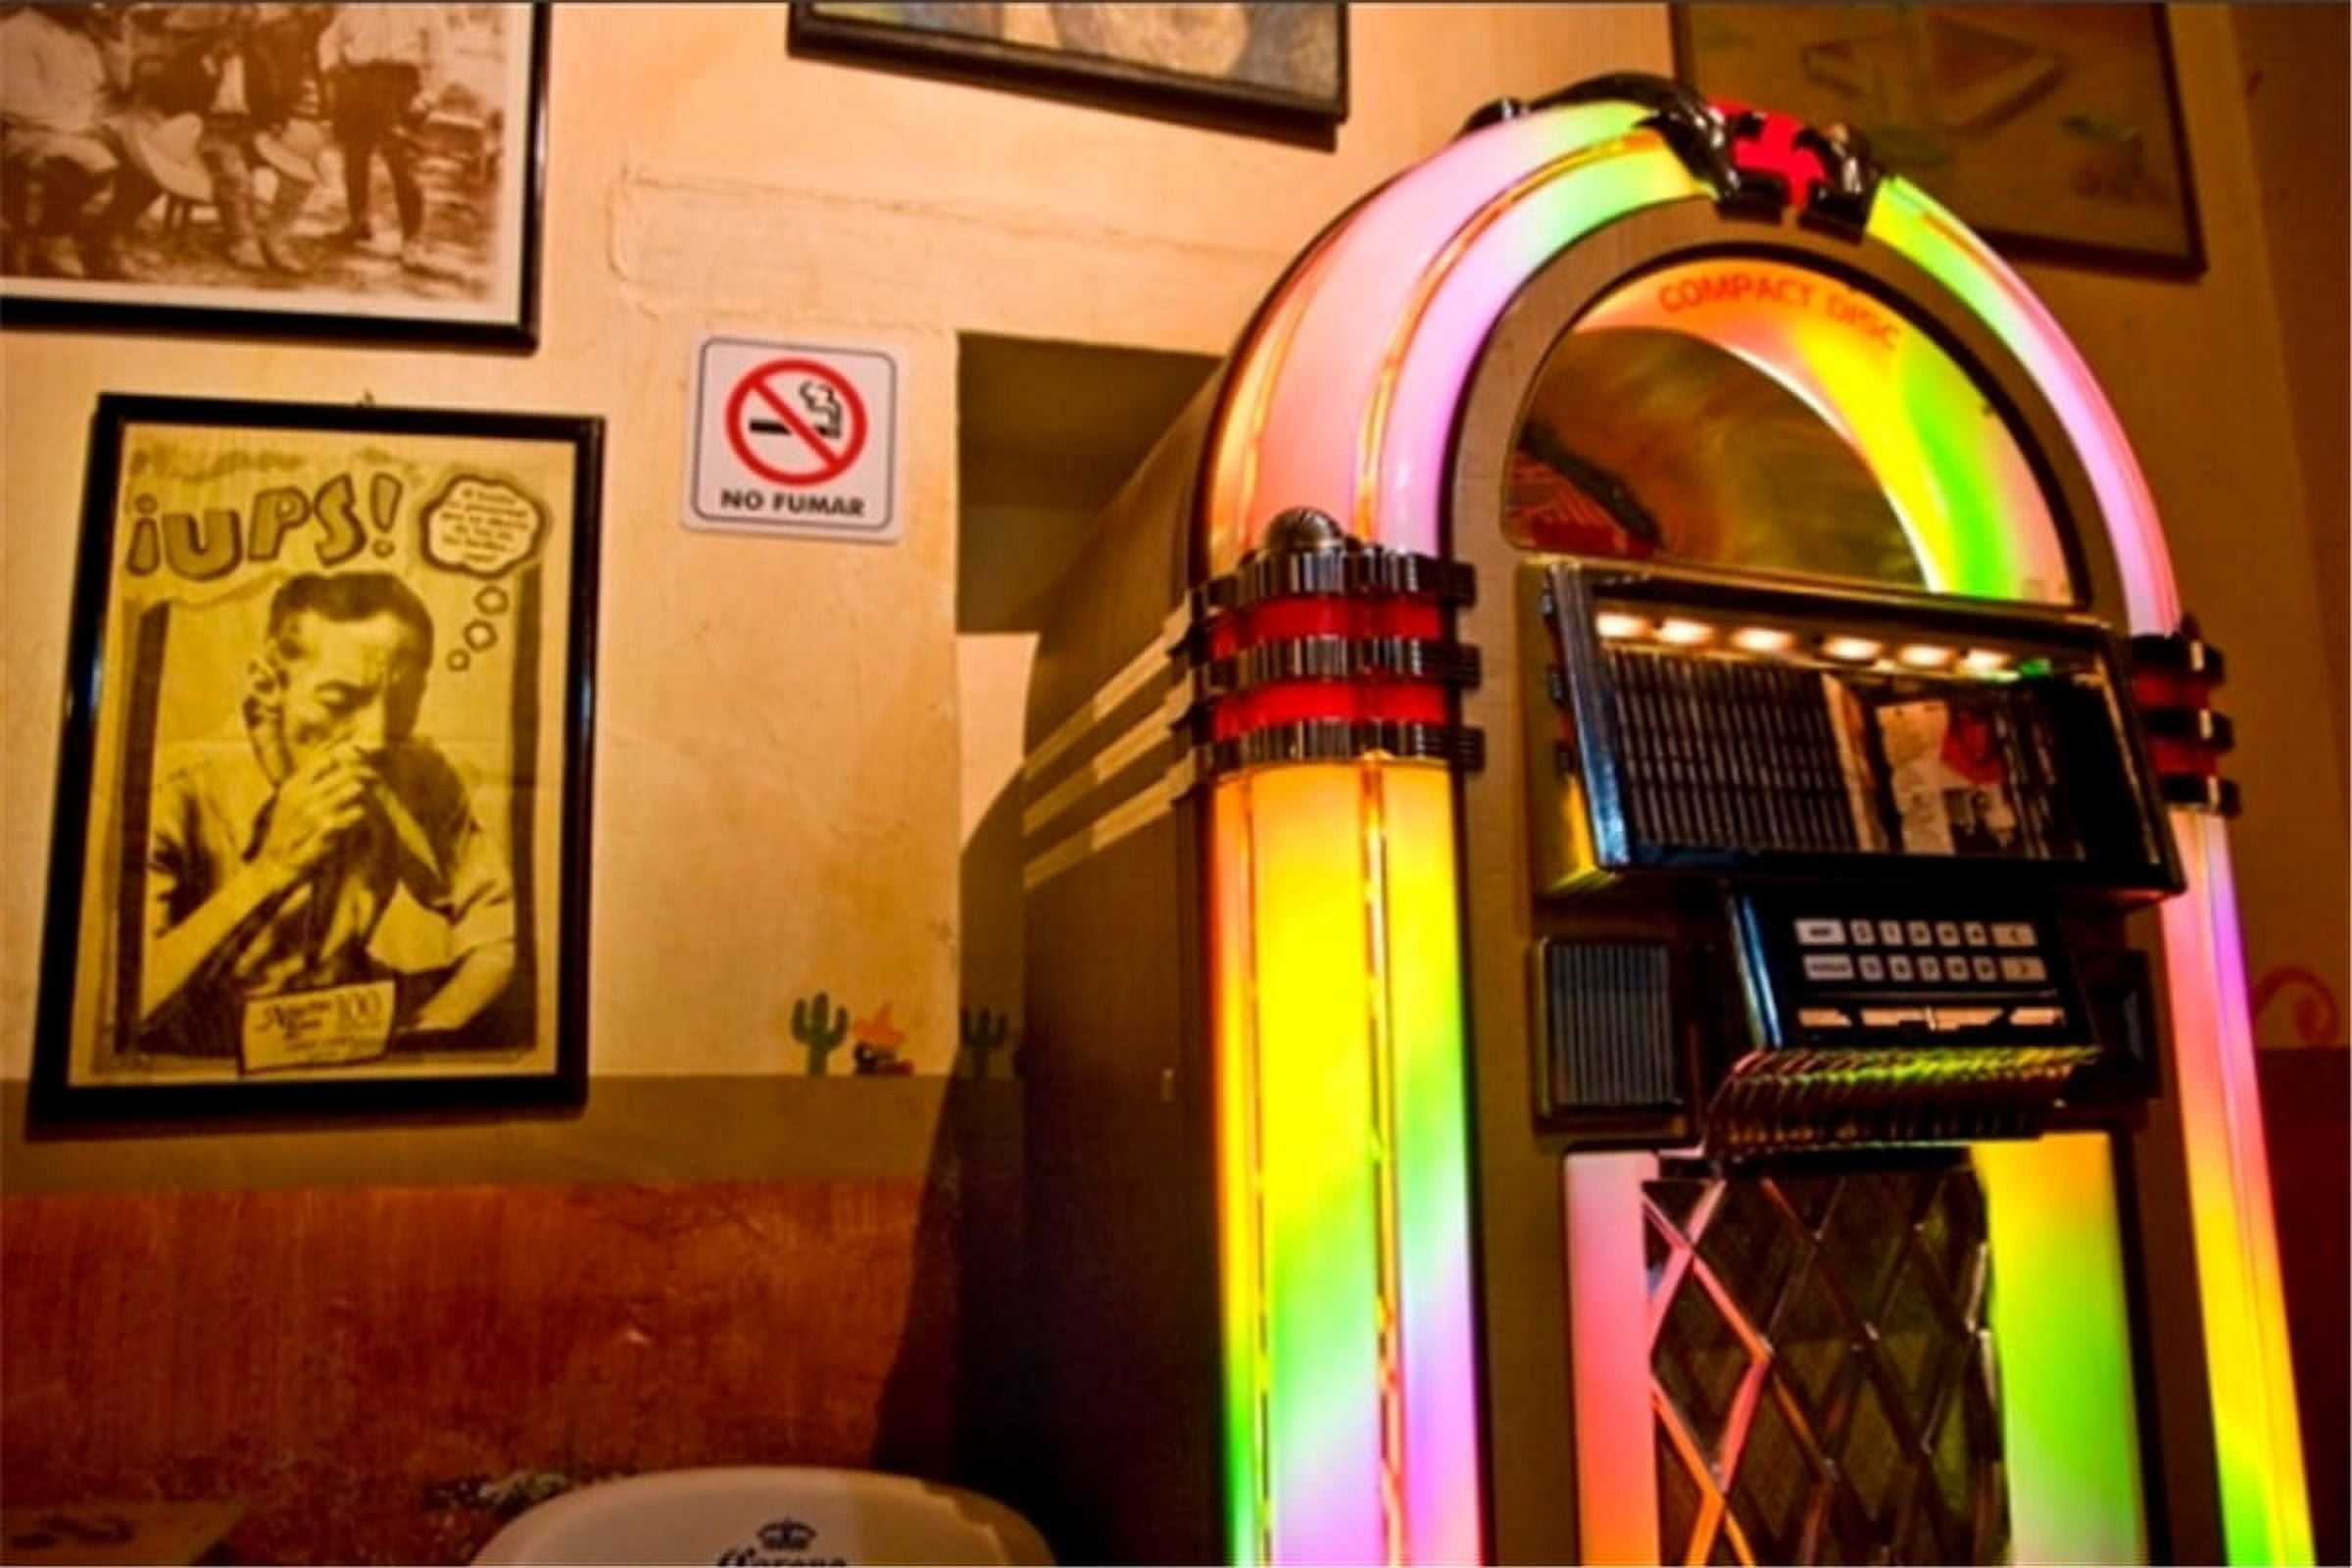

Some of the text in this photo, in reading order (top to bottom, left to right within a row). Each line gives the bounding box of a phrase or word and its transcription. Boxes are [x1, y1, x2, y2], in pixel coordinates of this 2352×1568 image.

[1657, 273, 1900, 349] COMPACT DISC
[720, 489, 864, 516] NO FUMAR
